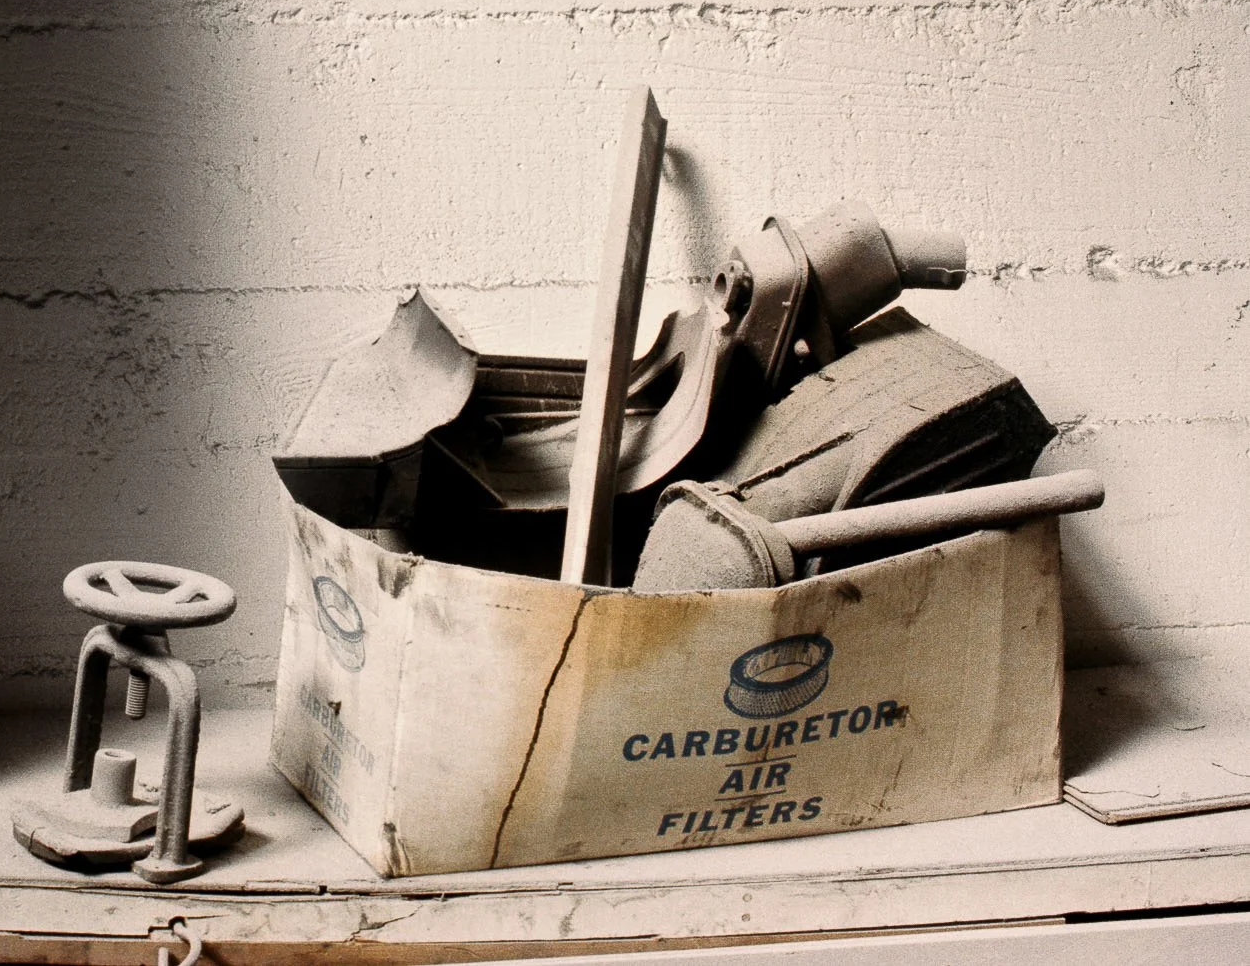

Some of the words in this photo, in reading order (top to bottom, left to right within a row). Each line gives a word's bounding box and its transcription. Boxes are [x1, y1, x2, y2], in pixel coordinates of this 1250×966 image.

[622, 700, 898, 762] CARBURETOR
[718, 762, 792, 795] AIR
[656, 796, 823, 836] FILTERS
